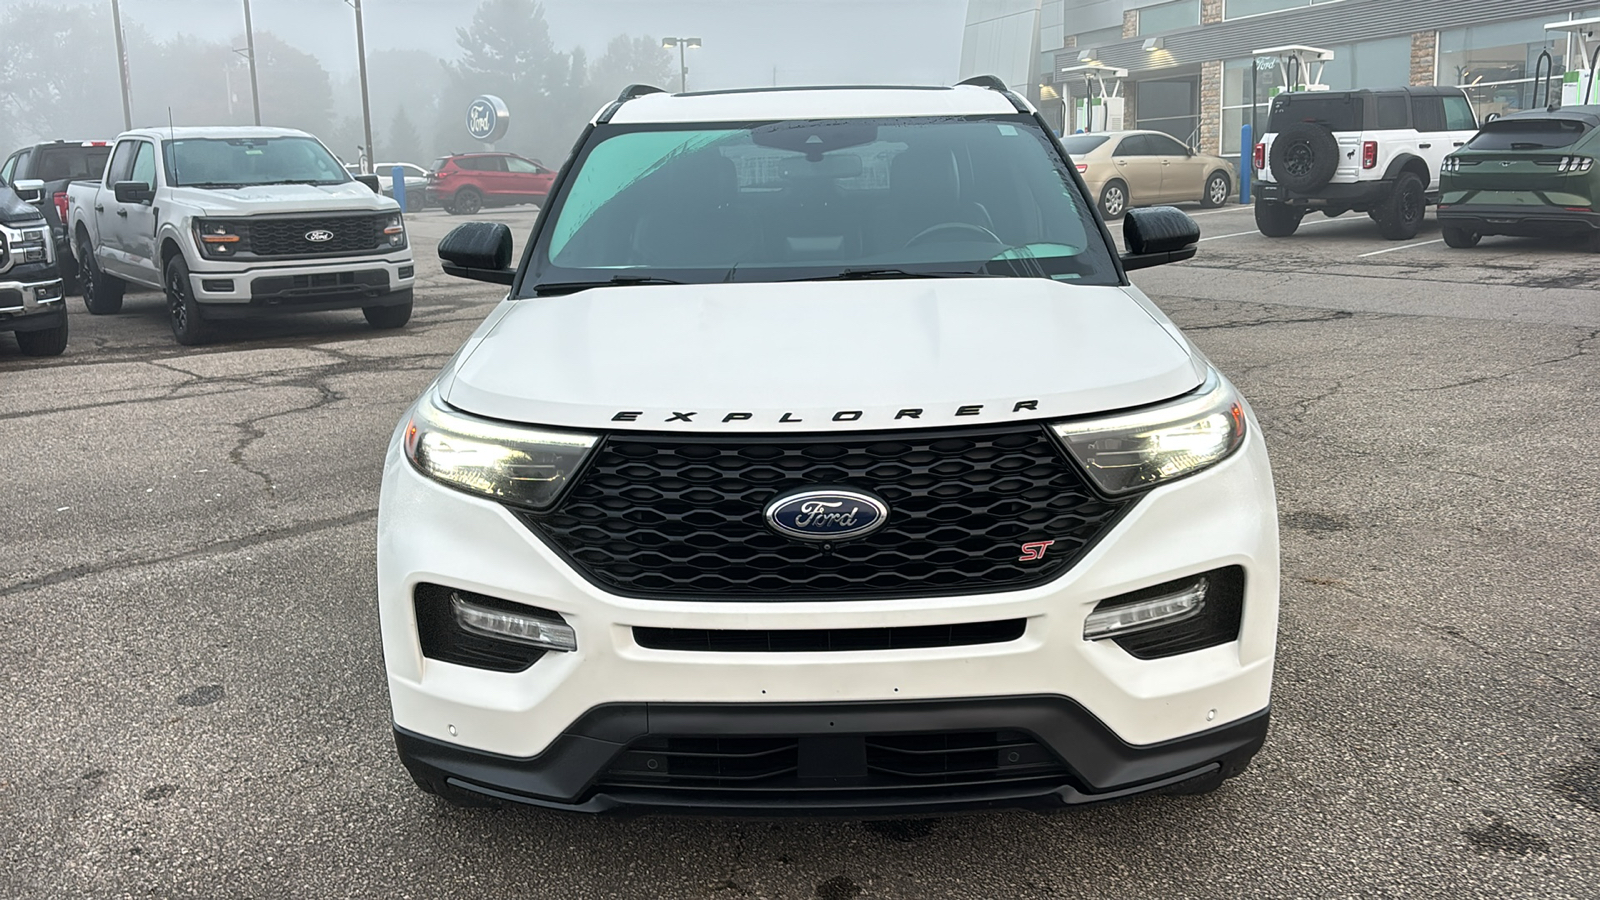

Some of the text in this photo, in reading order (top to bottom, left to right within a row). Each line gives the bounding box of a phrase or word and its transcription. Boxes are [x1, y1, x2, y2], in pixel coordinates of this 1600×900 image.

[1256, 56, 1276, 70] Ford
[470, 105, 490, 132] Ford
[611, 399, 1039, 423] EXPLORER
[795, 501, 859, 528] Ford
[1018, 540, 1055, 561] ST
